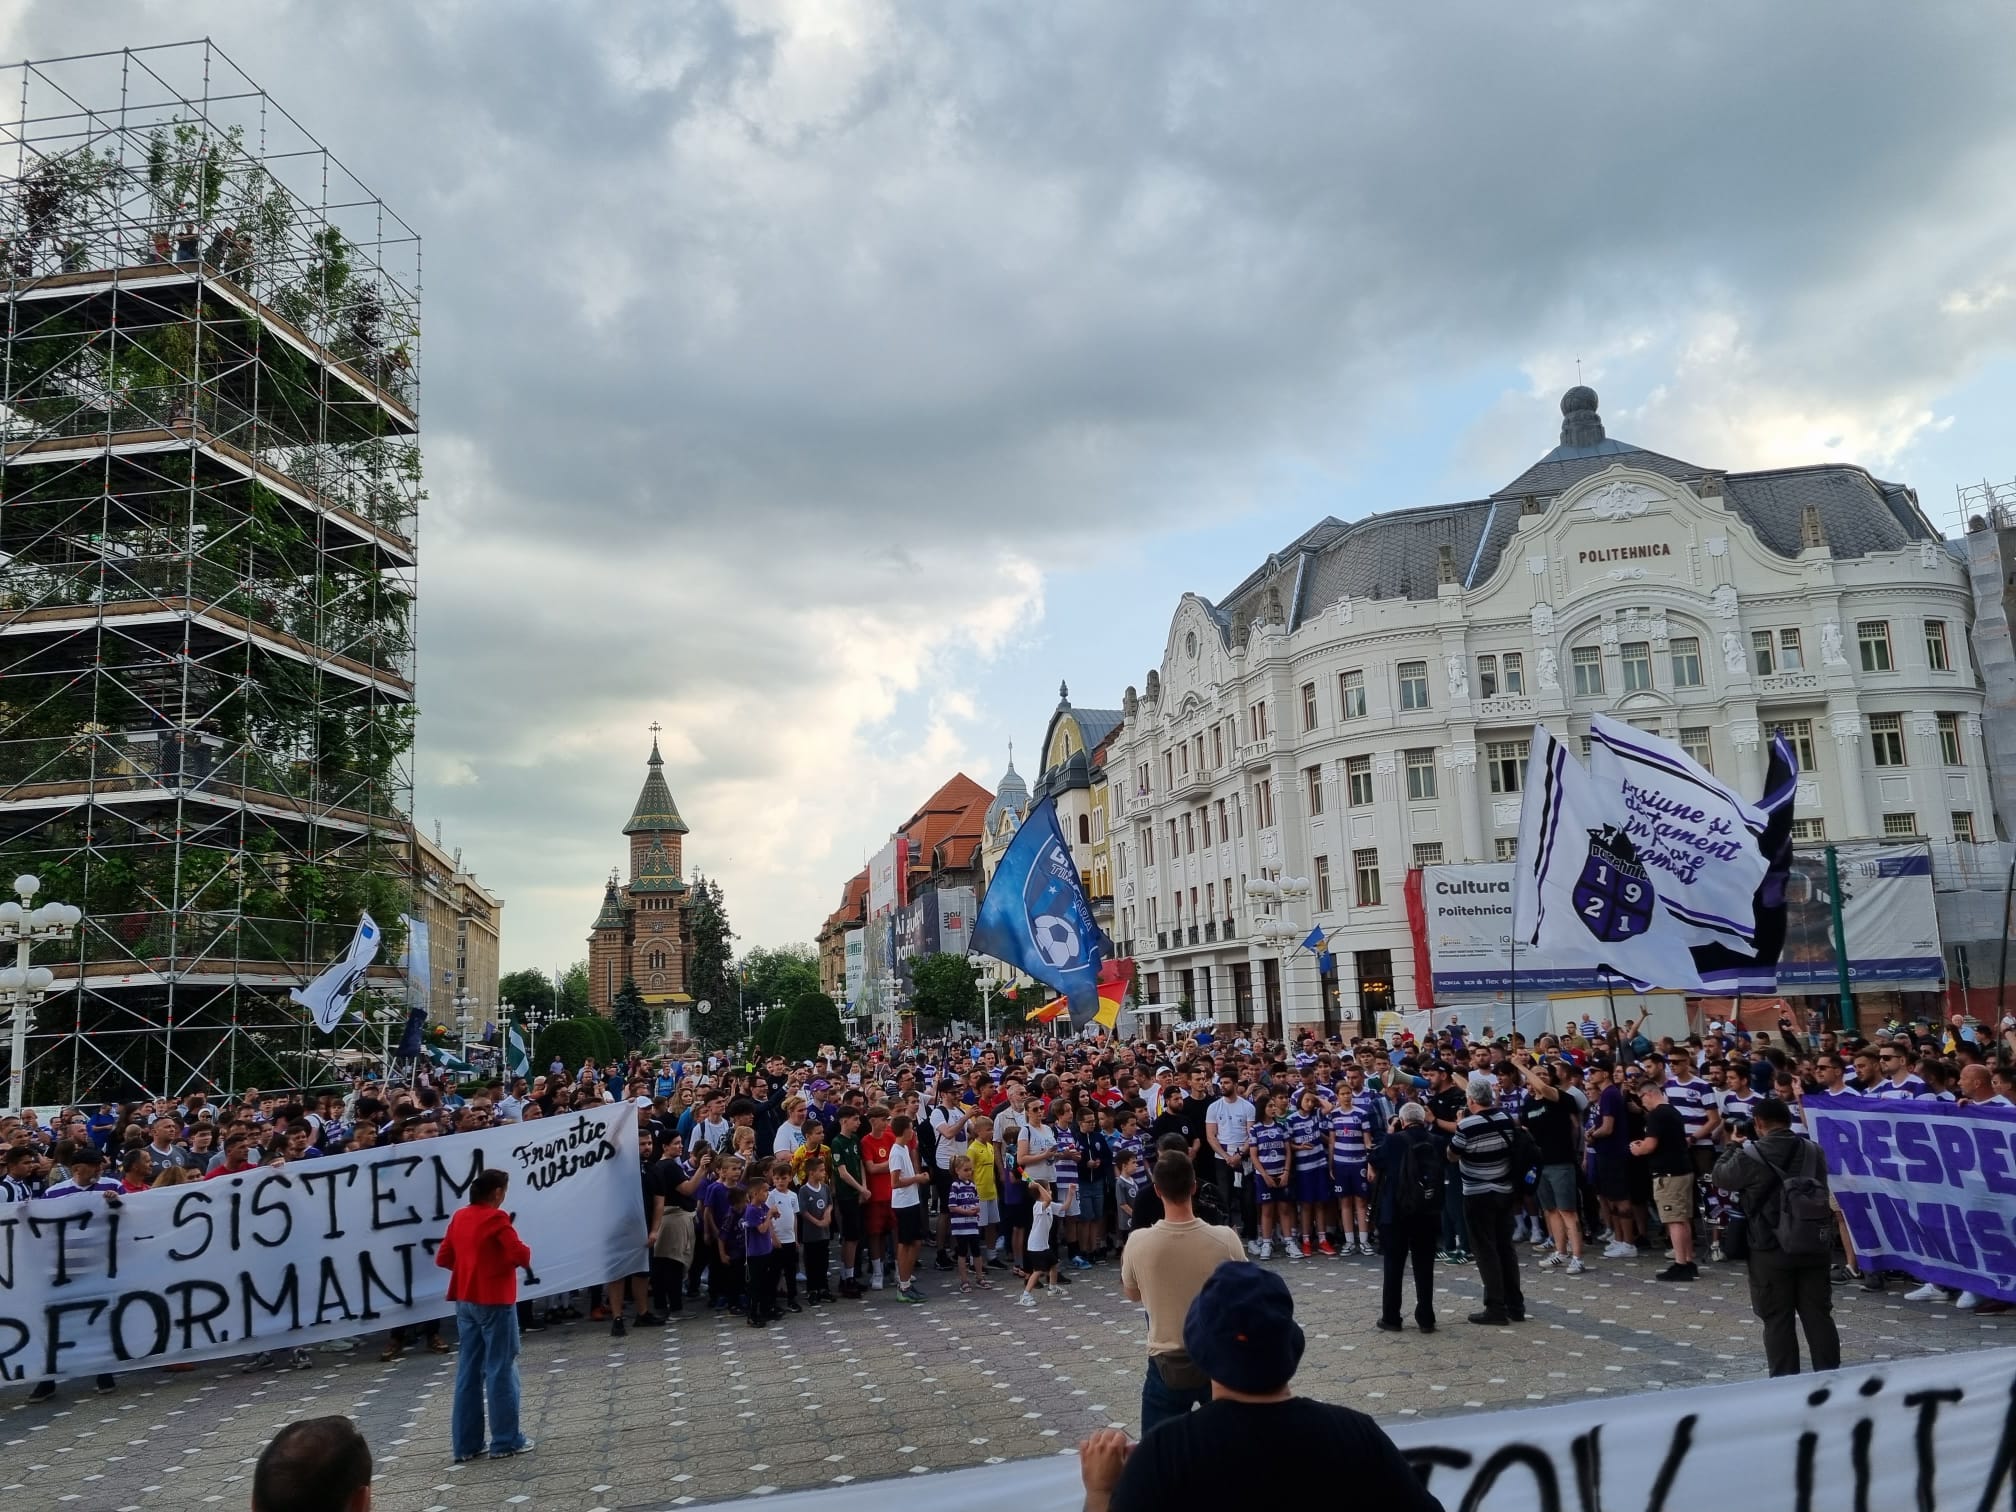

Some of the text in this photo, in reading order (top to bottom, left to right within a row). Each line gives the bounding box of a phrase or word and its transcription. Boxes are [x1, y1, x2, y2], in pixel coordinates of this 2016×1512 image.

[1579, 543, 1671, 564] POLITEHNICA
[1436, 880, 1510, 894] Cultura
[1596, 865, 1642, 903] 1 9
[1438, 904, 1512, 917] Politehnica
[1584, 896, 1631, 932] 2 1
[512, 1115, 606, 1169] Frenetic
[1816, 1117, 2016, 1196] RESPE
